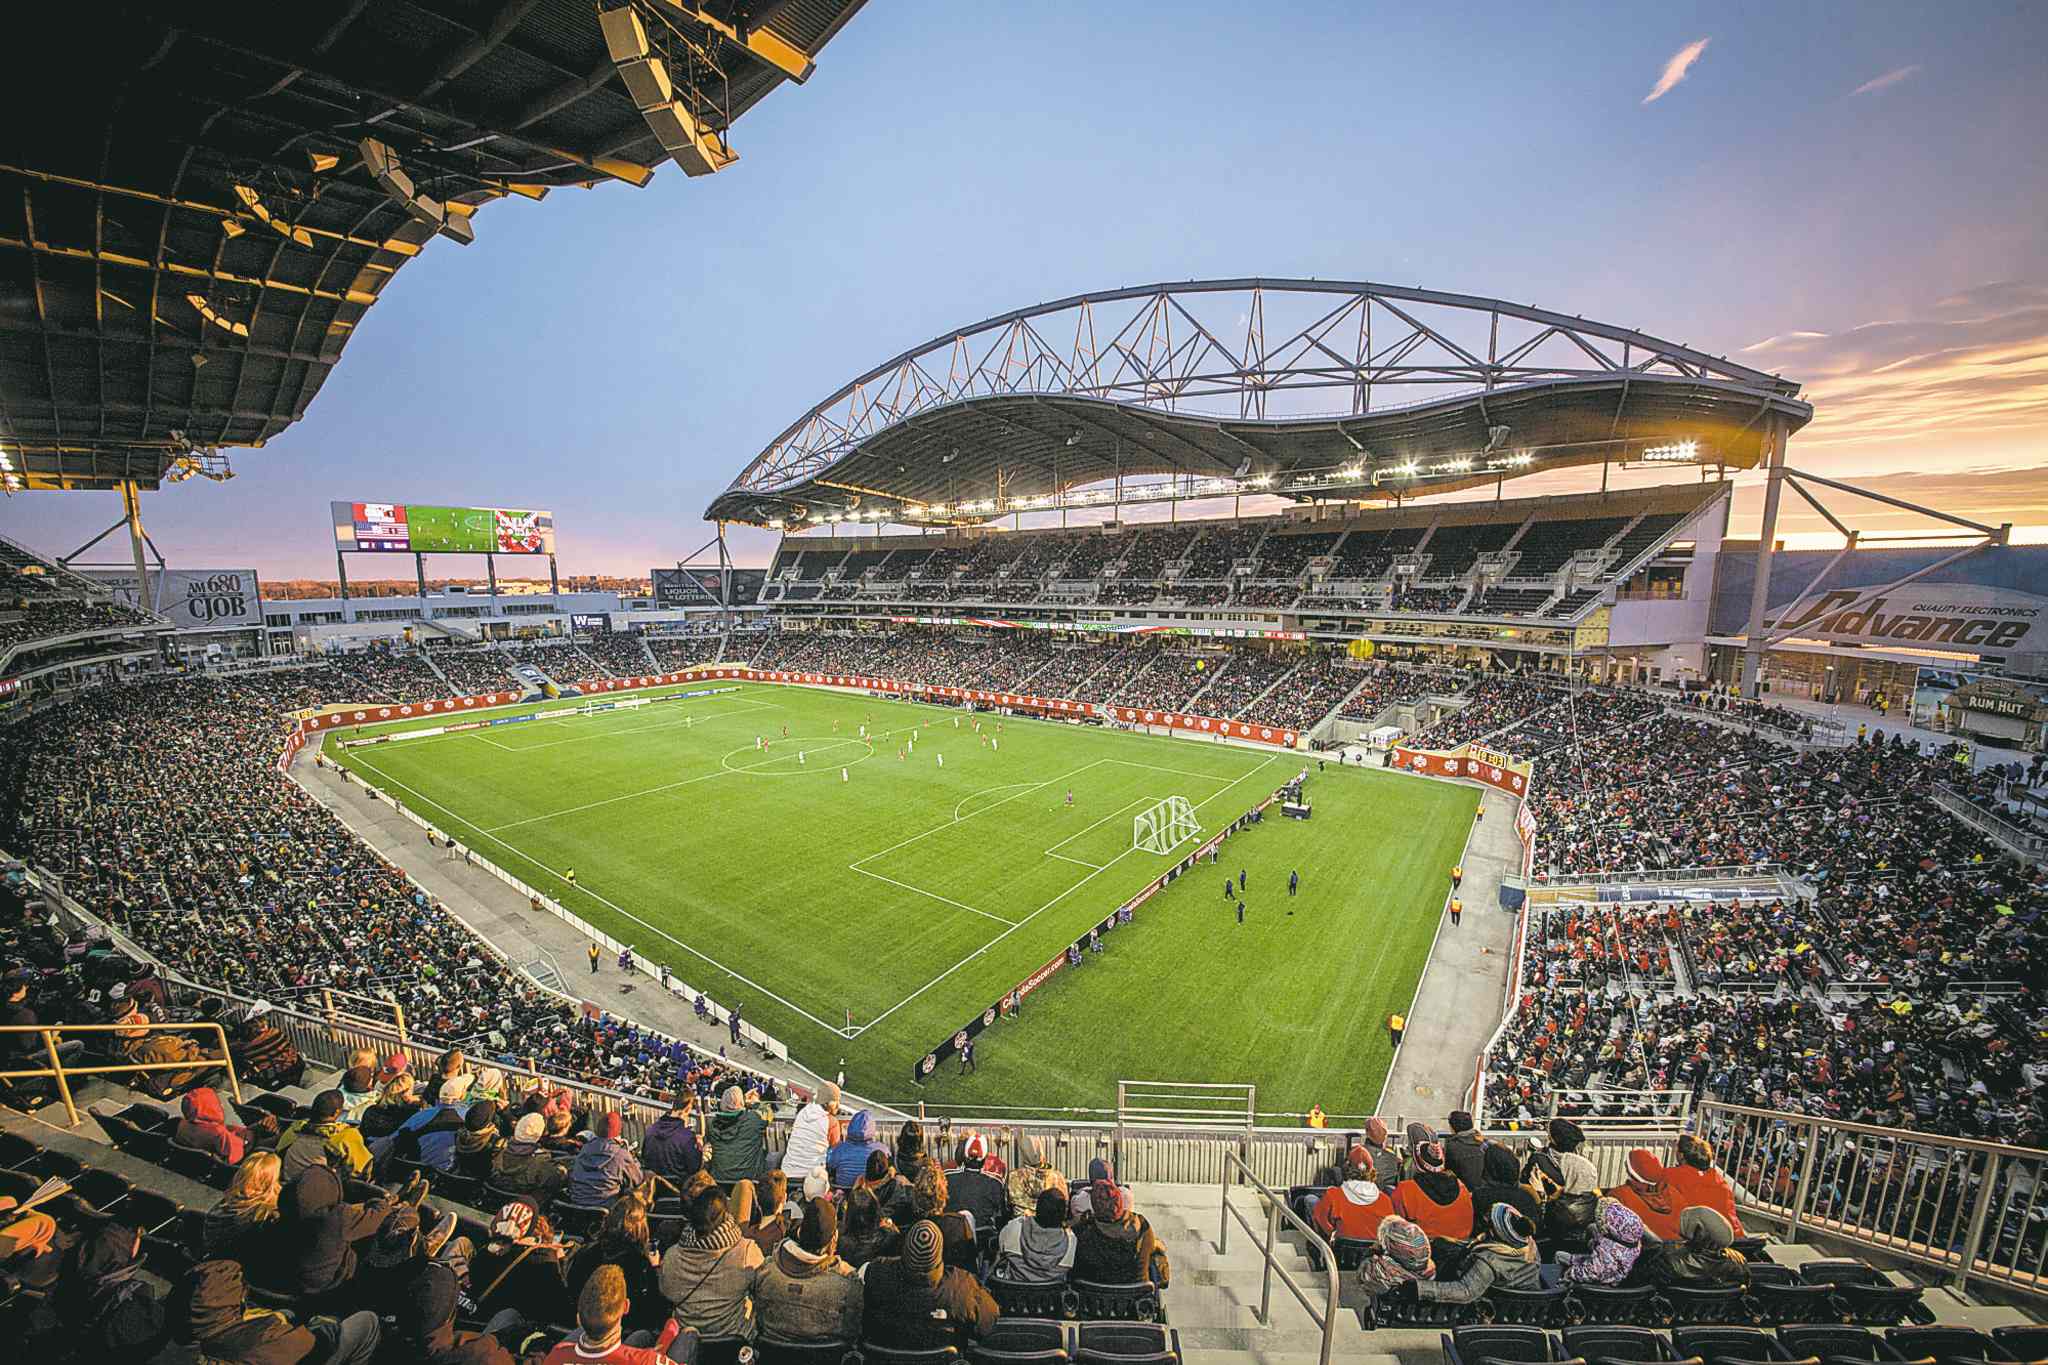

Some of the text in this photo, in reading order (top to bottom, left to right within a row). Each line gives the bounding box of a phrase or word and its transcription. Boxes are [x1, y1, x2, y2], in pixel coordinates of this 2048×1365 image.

[188, 574, 241, 593] AM 680
[188, 597, 247, 621] CJOB
[1763, 591, 2031, 648] Advance
[1911, 604, 2040, 617] QUALITY ELECTRONICS
[1968, 696, 2024, 714] RUM HUT
[1002, 956, 1065, 1009] CaadaSoccer.com
